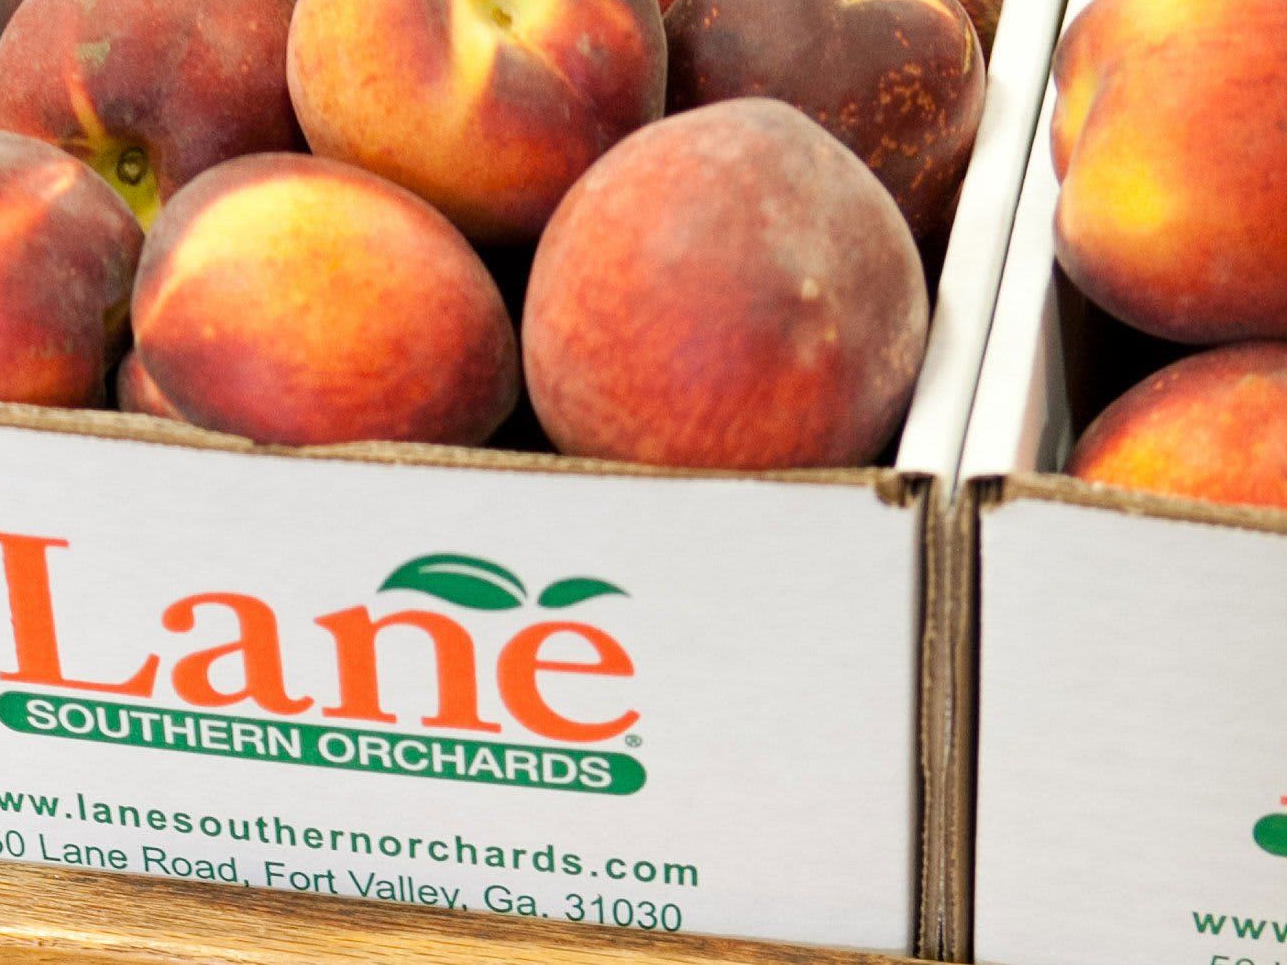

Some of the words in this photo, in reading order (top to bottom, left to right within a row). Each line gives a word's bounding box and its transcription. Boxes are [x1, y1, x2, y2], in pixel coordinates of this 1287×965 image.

[26, 699, 303, 759] SOUTHERN
[317, 732, 612, 789] ORCHARDS
[39, 833, 128, 869] Lane
[142, 846, 250, 887] Road,
[265, 860, 338, 894] Fort
[348, 870, 468, 912] Valley,
[483, 885, 549, 917] Ga.
[565, 893, 682, 932] 31030
